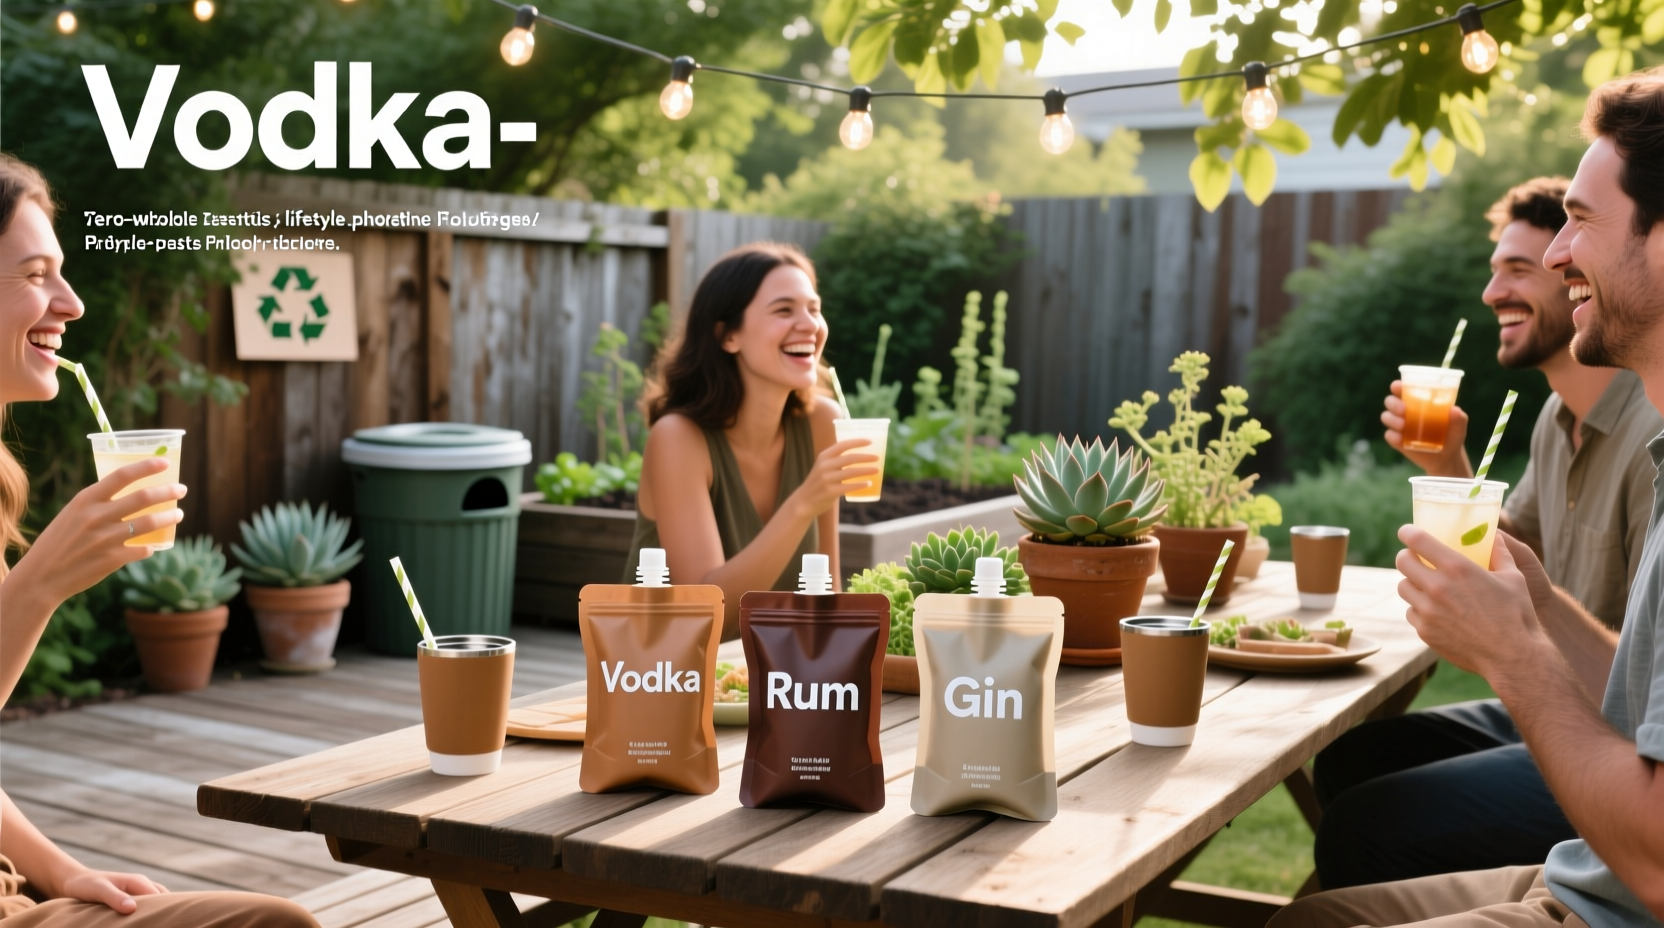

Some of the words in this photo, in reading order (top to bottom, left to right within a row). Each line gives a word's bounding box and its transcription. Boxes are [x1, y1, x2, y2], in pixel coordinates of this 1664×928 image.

[601, 660, 700, 693] Vodka
[767, 671, 859, 711] Rum
[944, 676, 1023, 720] Gin
